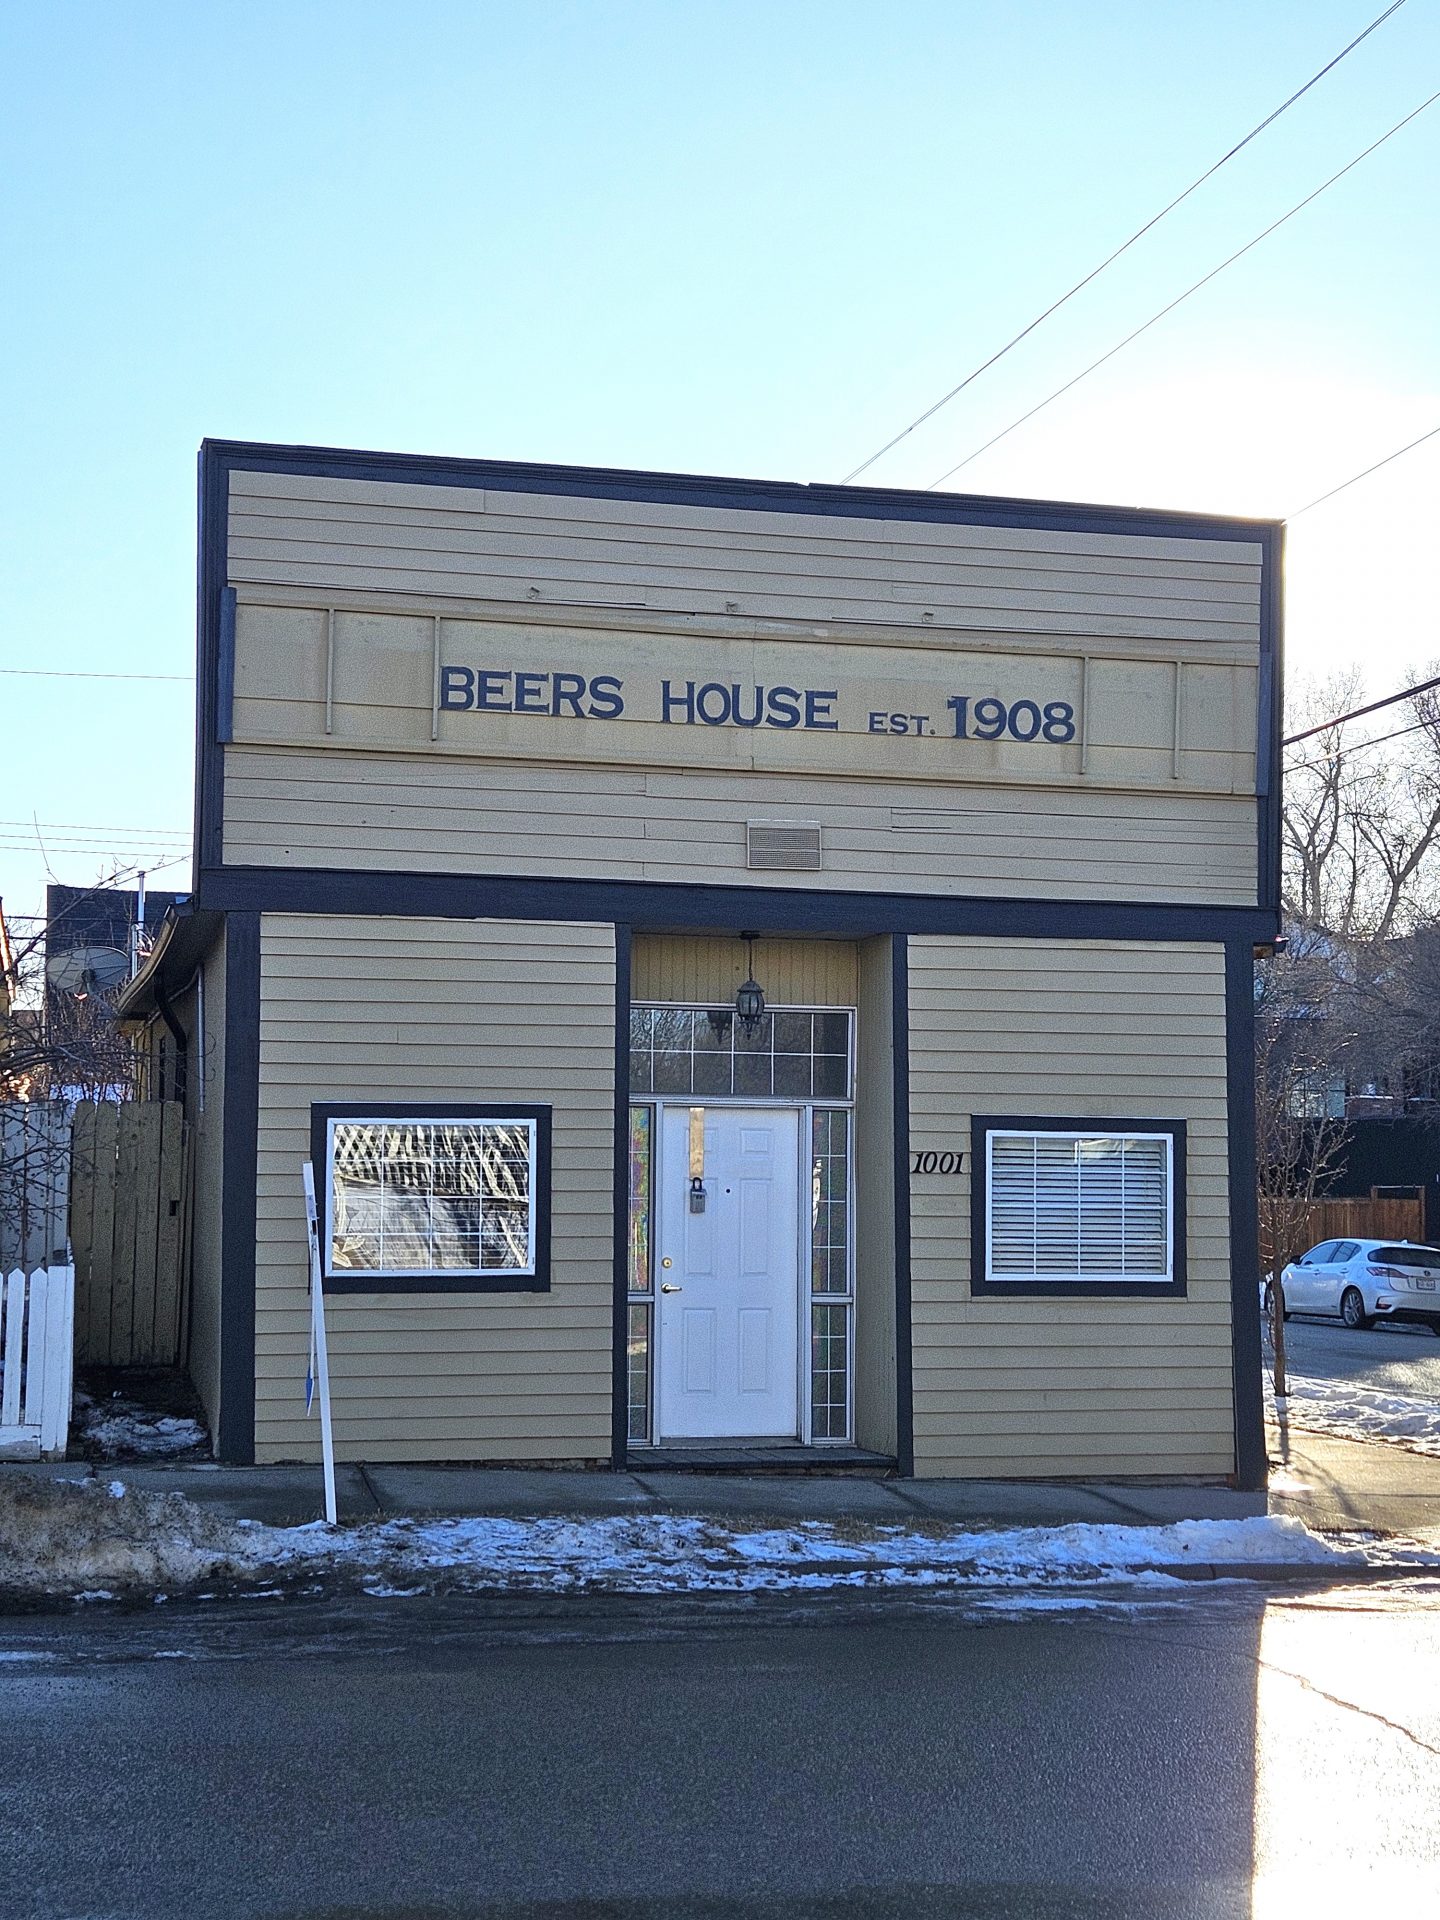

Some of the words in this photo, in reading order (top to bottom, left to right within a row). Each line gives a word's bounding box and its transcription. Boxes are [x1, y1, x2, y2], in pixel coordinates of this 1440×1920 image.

[439, 666, 625, 719] BEERS
[660, 680, 839, 730] HOUSE
[868, 711, 936, 736] EST.
[947, 695, 1076, 743] 1908
[912, 1151, 964, 1174] 1001
